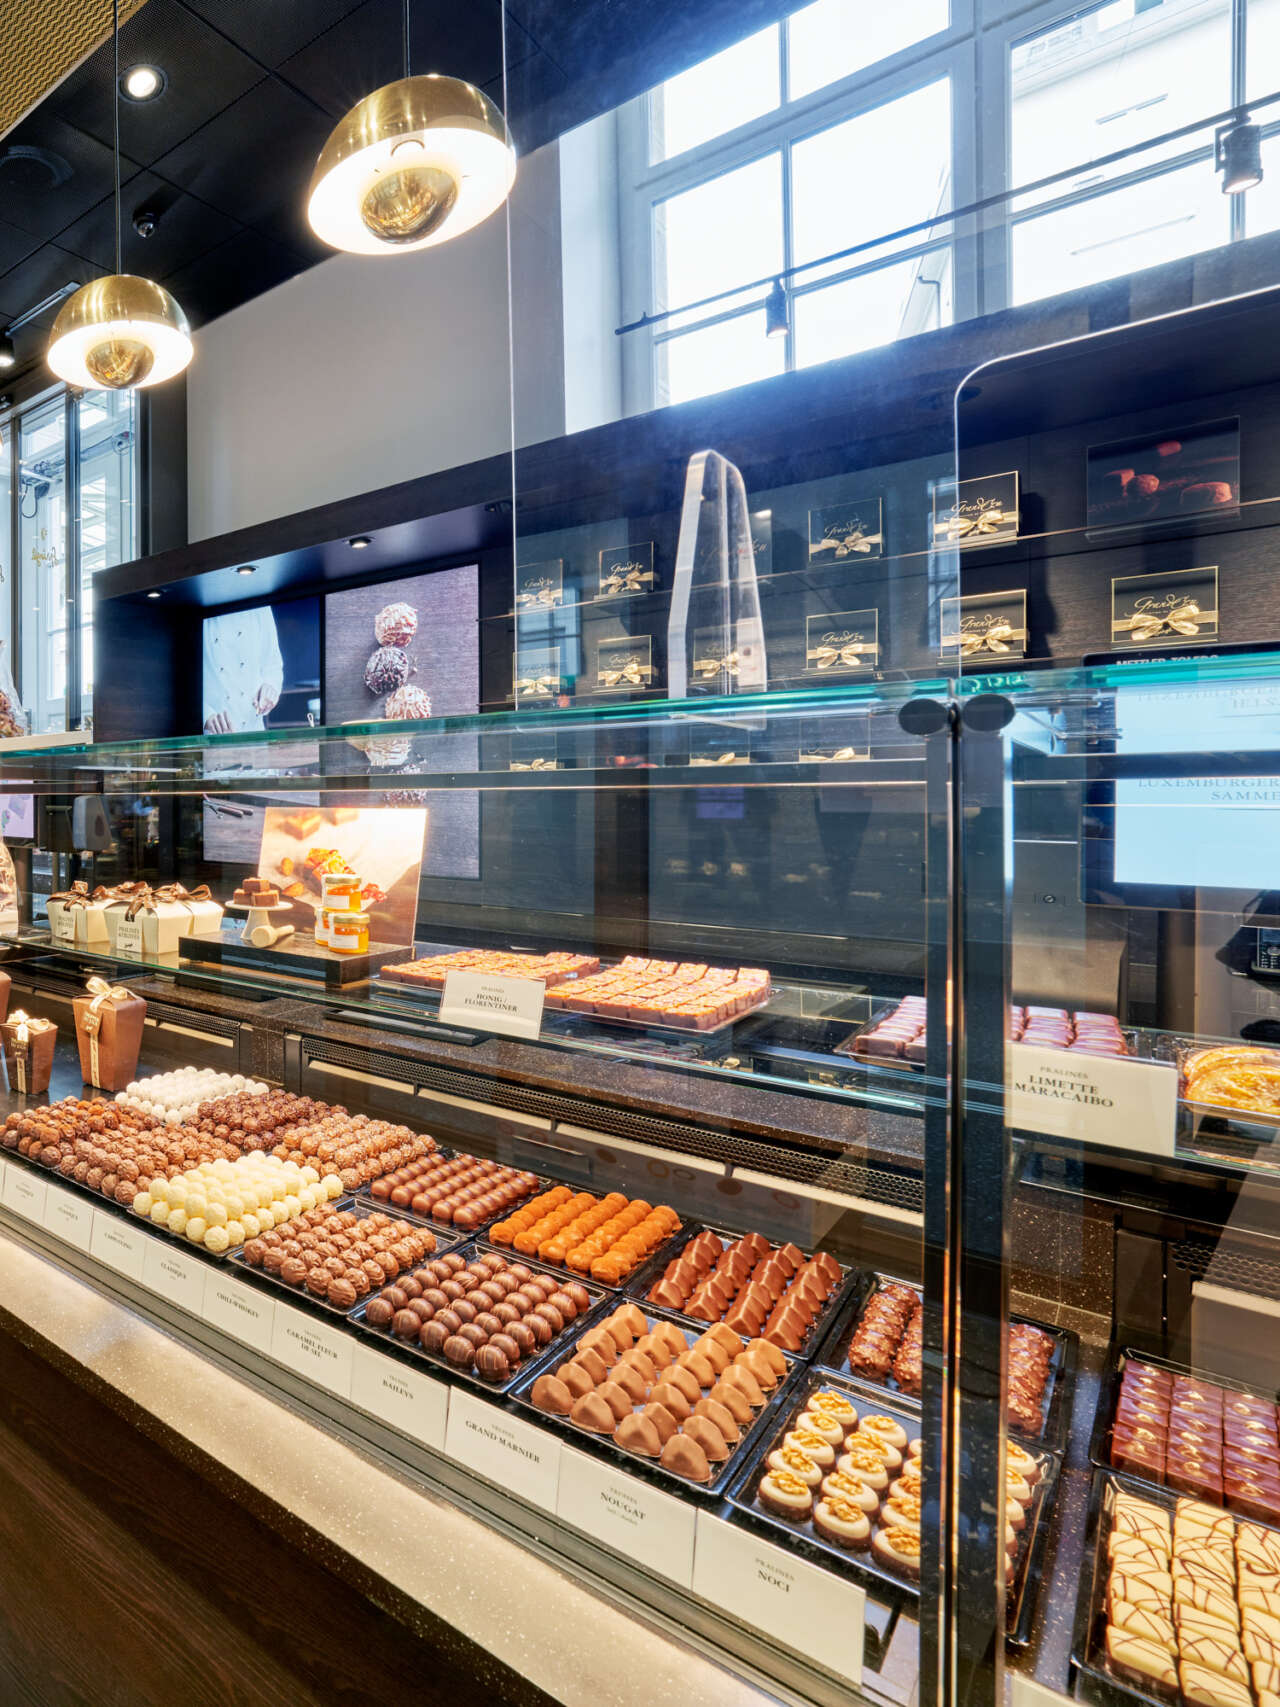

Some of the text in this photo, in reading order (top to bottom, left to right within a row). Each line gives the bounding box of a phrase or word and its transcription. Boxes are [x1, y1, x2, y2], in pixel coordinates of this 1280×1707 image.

[464, 998, 518, 1013] FLORENTINER
[1014, 1081, 1114, 1108] MARACAIBO
[1029, 1074, 1099, 1096] LIMETTE
[382, 1378, 414, 1400] BAILEYS
[465, 1420, 498, 1442] GRAND
[498, 1436, 540, 1464] MARNIER
[600, 1491, 647, 1520] NOUGAT
[758, 1569, 790, 1593] NOCI
